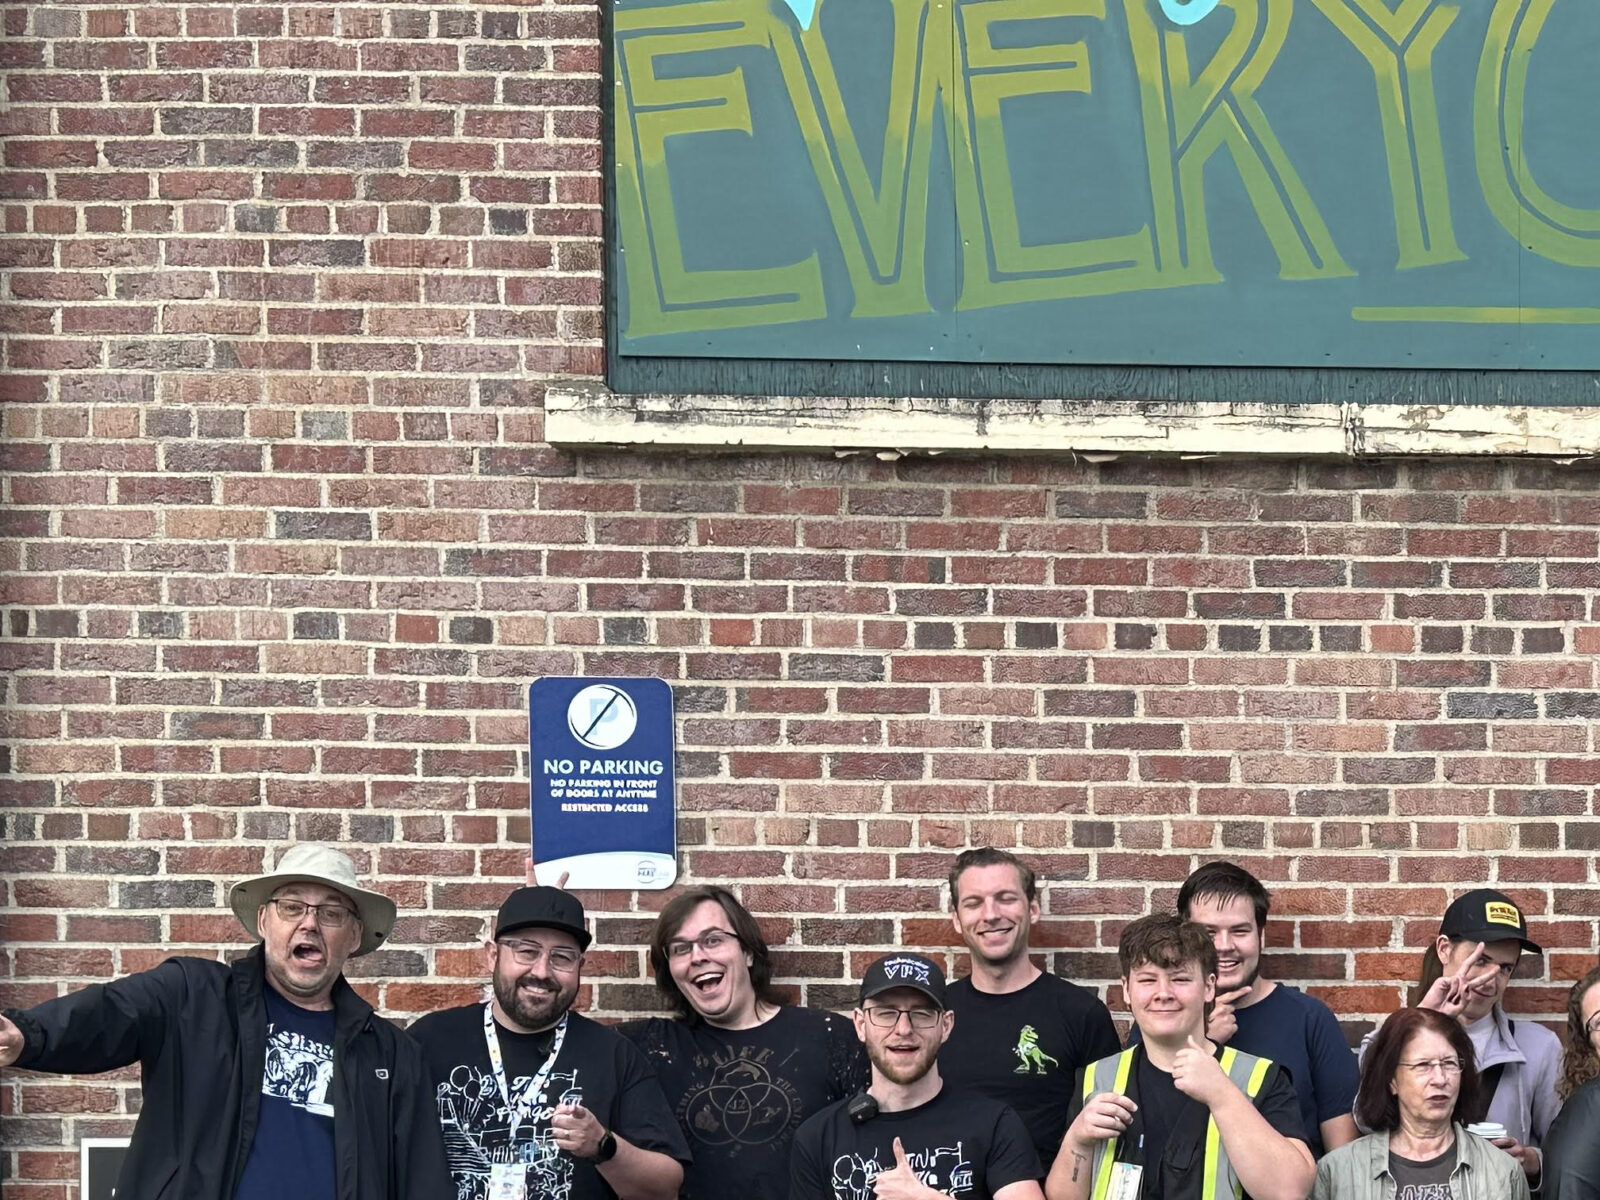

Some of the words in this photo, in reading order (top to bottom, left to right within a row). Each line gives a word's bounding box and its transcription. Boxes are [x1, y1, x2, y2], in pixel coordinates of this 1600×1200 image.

[543, 759, 574, 774] NO
[579, 760, 664, 775] PARKING
[550, 779, 566, 787] NO
[568, 779, 611, 788] PARKING
[613, 780, 625, 788] IN
[626, 780, 657, 788] FRONT
[550, 789, 564, 797] OF
[566, 789, 599, 798] DOORS
[601, 789, 613, 798] AT
[615, 790, 657, 798] ANYTIME
[561, 803, 612, 812] RESTRICTED
[614, 803, 649, 813] ACCESS
